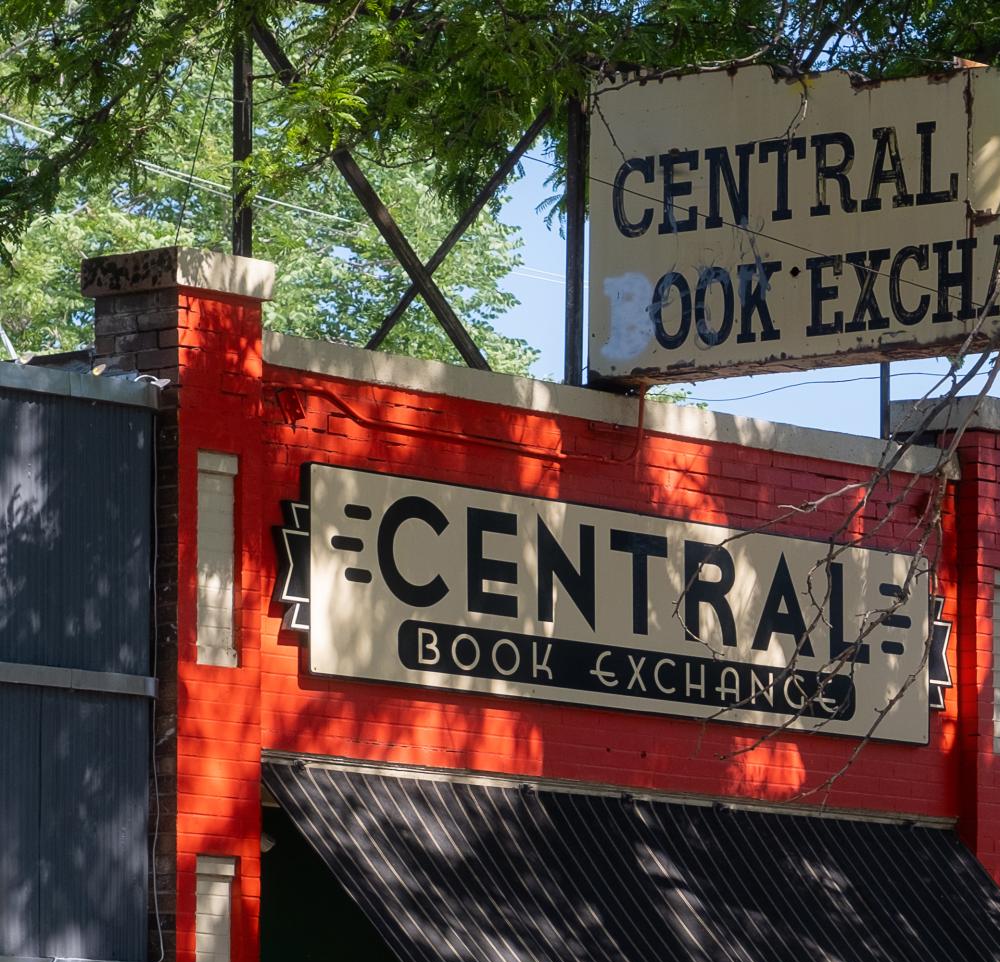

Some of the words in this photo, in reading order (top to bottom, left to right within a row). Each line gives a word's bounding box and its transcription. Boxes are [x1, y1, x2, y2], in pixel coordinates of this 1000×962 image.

[612, 121, 958, 239] CENTRAL
[602, 260, 782, 359] OOK
[376, 495, 871, 665] CENTRAL
[416, 624, 555, 680] BOOK
[589, 648, 838, 714] EXCHANGE
